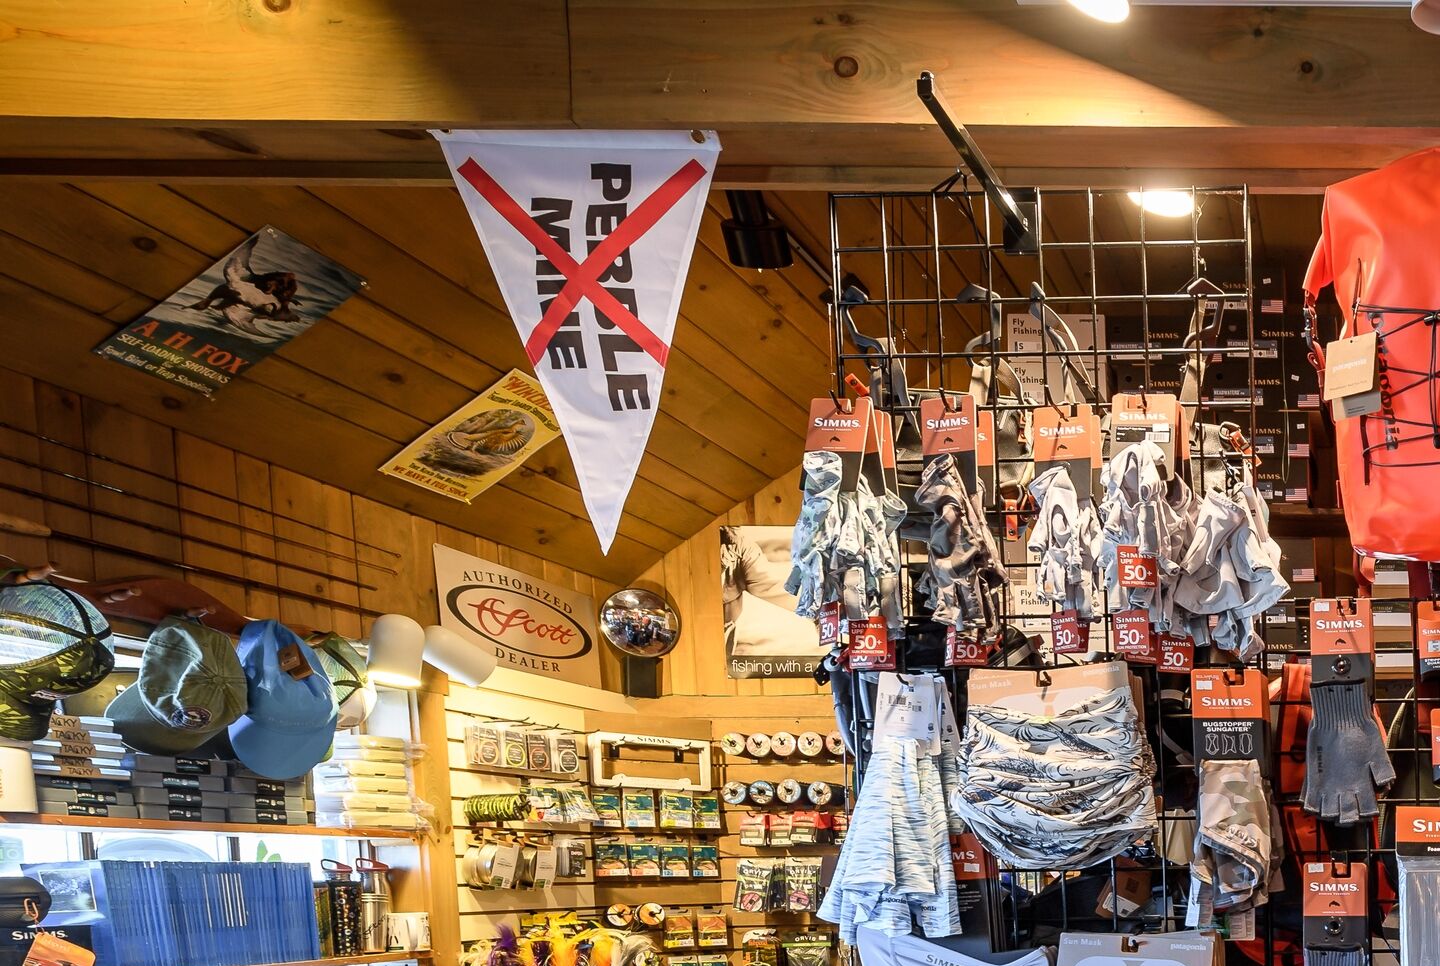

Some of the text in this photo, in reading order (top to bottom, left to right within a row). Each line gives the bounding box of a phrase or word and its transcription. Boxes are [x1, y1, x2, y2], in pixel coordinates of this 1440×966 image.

[1013, 319, 1024, 327] Fly
[1013, 328, 1042, 336] Fishing
[117, 333, 231, 384] SELF-LOADING SHOTGUNS
[192, 344, 249, 375] FOX
[124, 354, 147, 367] Bird
[145, 363, 157, 371] or
[155, 365, 175, 381] Trap
[1019, 376, 1044, 384] ishing
[814, 418, 859, 428] SIMMS
[926, 417, 967, 429] SIMMS
[1119, 413, 1166, 421] SIMMS
[1039, 425, 1083, 437] SIMMS
[404, 470, 427, 481] HAVE
[430, 480, 448, 490] FULL
[447, 487, 469, 497] STOCK
[1124, 565, 1152, 581] 50+
[463, 570, 573, 614] AUTHORIZED
[467, 598, 577, 645] Scott
[1316, 619, 1362, 630] SIMMS
[821, 622, 836, 639] 50+
[854, 634, 882, 650] 50+
[1056, 629, 1075, 645] 50+
[1119, 630, 1144, 645] 50+
[957, 644, 982, 659] 50+
[495, 647, 561, 672] DEALER
[1164, 653, 1189, 666] 50+
[732, 660, 813, 675] fishing with a
[1202, 696, 1251, 707] SIMMS
[51, 717, 78, 728] ACKY
[53, 730, 88, 741] TACKY
[637, 736, 671, 744] SIMMS
[64, 744, 95, 755] TACKY
[68, 767, 95, 776] TACKY
[1310, 882, 1356, 892] SIMMS
[1080, 938, 1102, 946] Mask
[1170, 943, 1207, 951] patagonia
